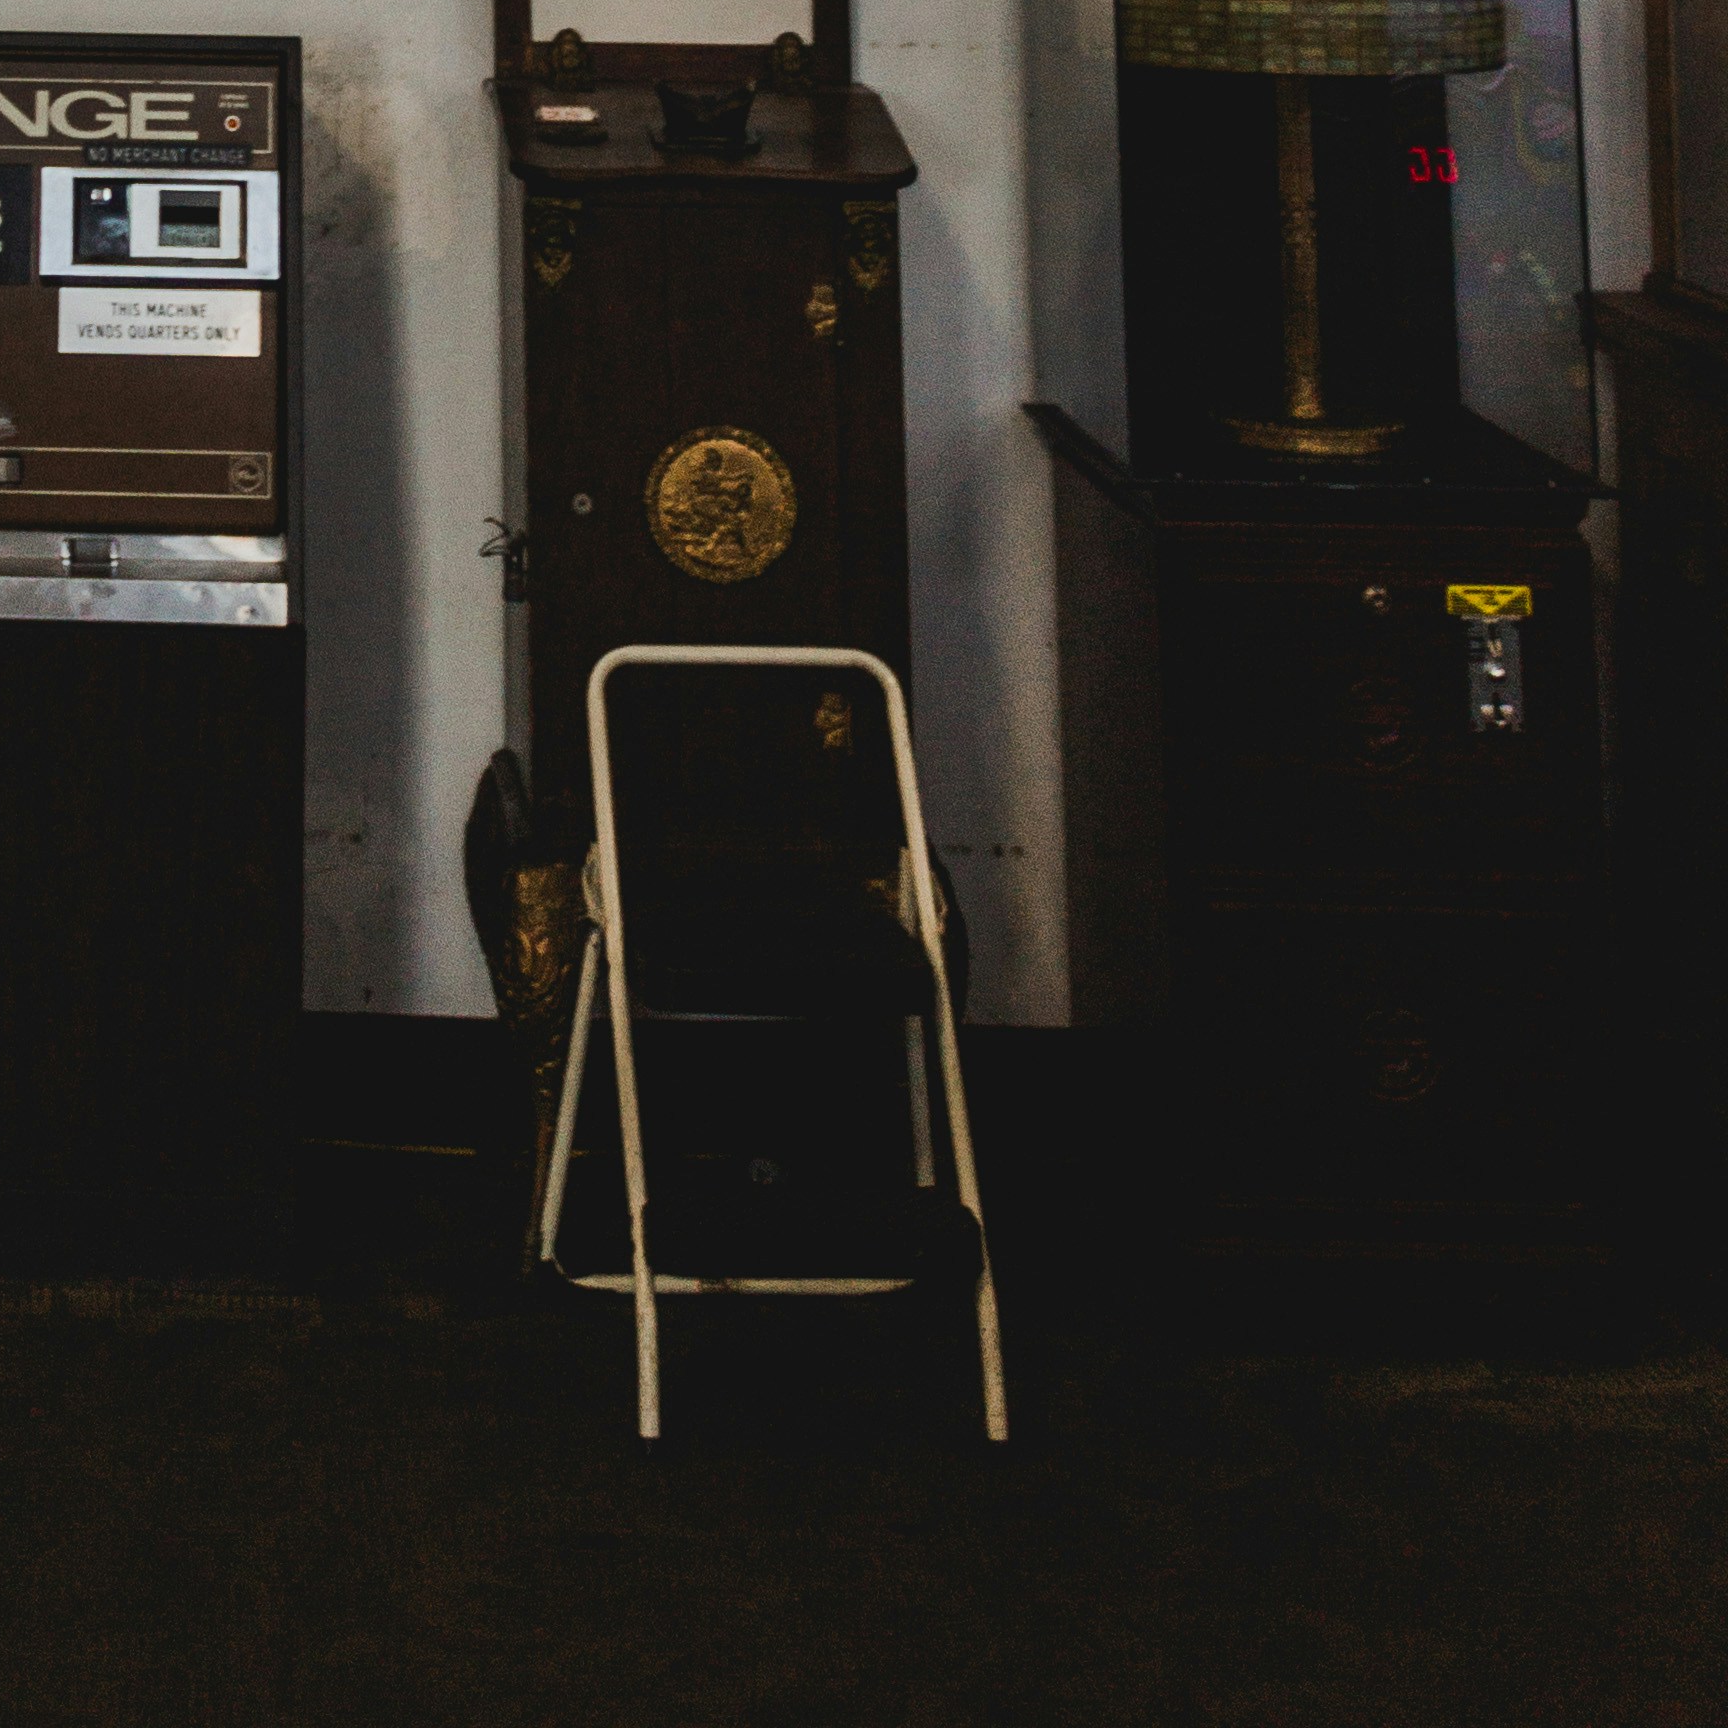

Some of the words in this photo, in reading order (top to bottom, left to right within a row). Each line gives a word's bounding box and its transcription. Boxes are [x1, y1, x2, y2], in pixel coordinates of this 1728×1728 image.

[112, 146, 187, 164] MERCHANT
[189, 147, 247, 166] CHANGE
[110, 301, 141, 319] THIS
[146, 302, 209, 320] MACHINE
[77, 322, 123, 340] VENDS
[128, 323, 198, 341] QUARTERS
[204, 324, 242, 343] ONLY
